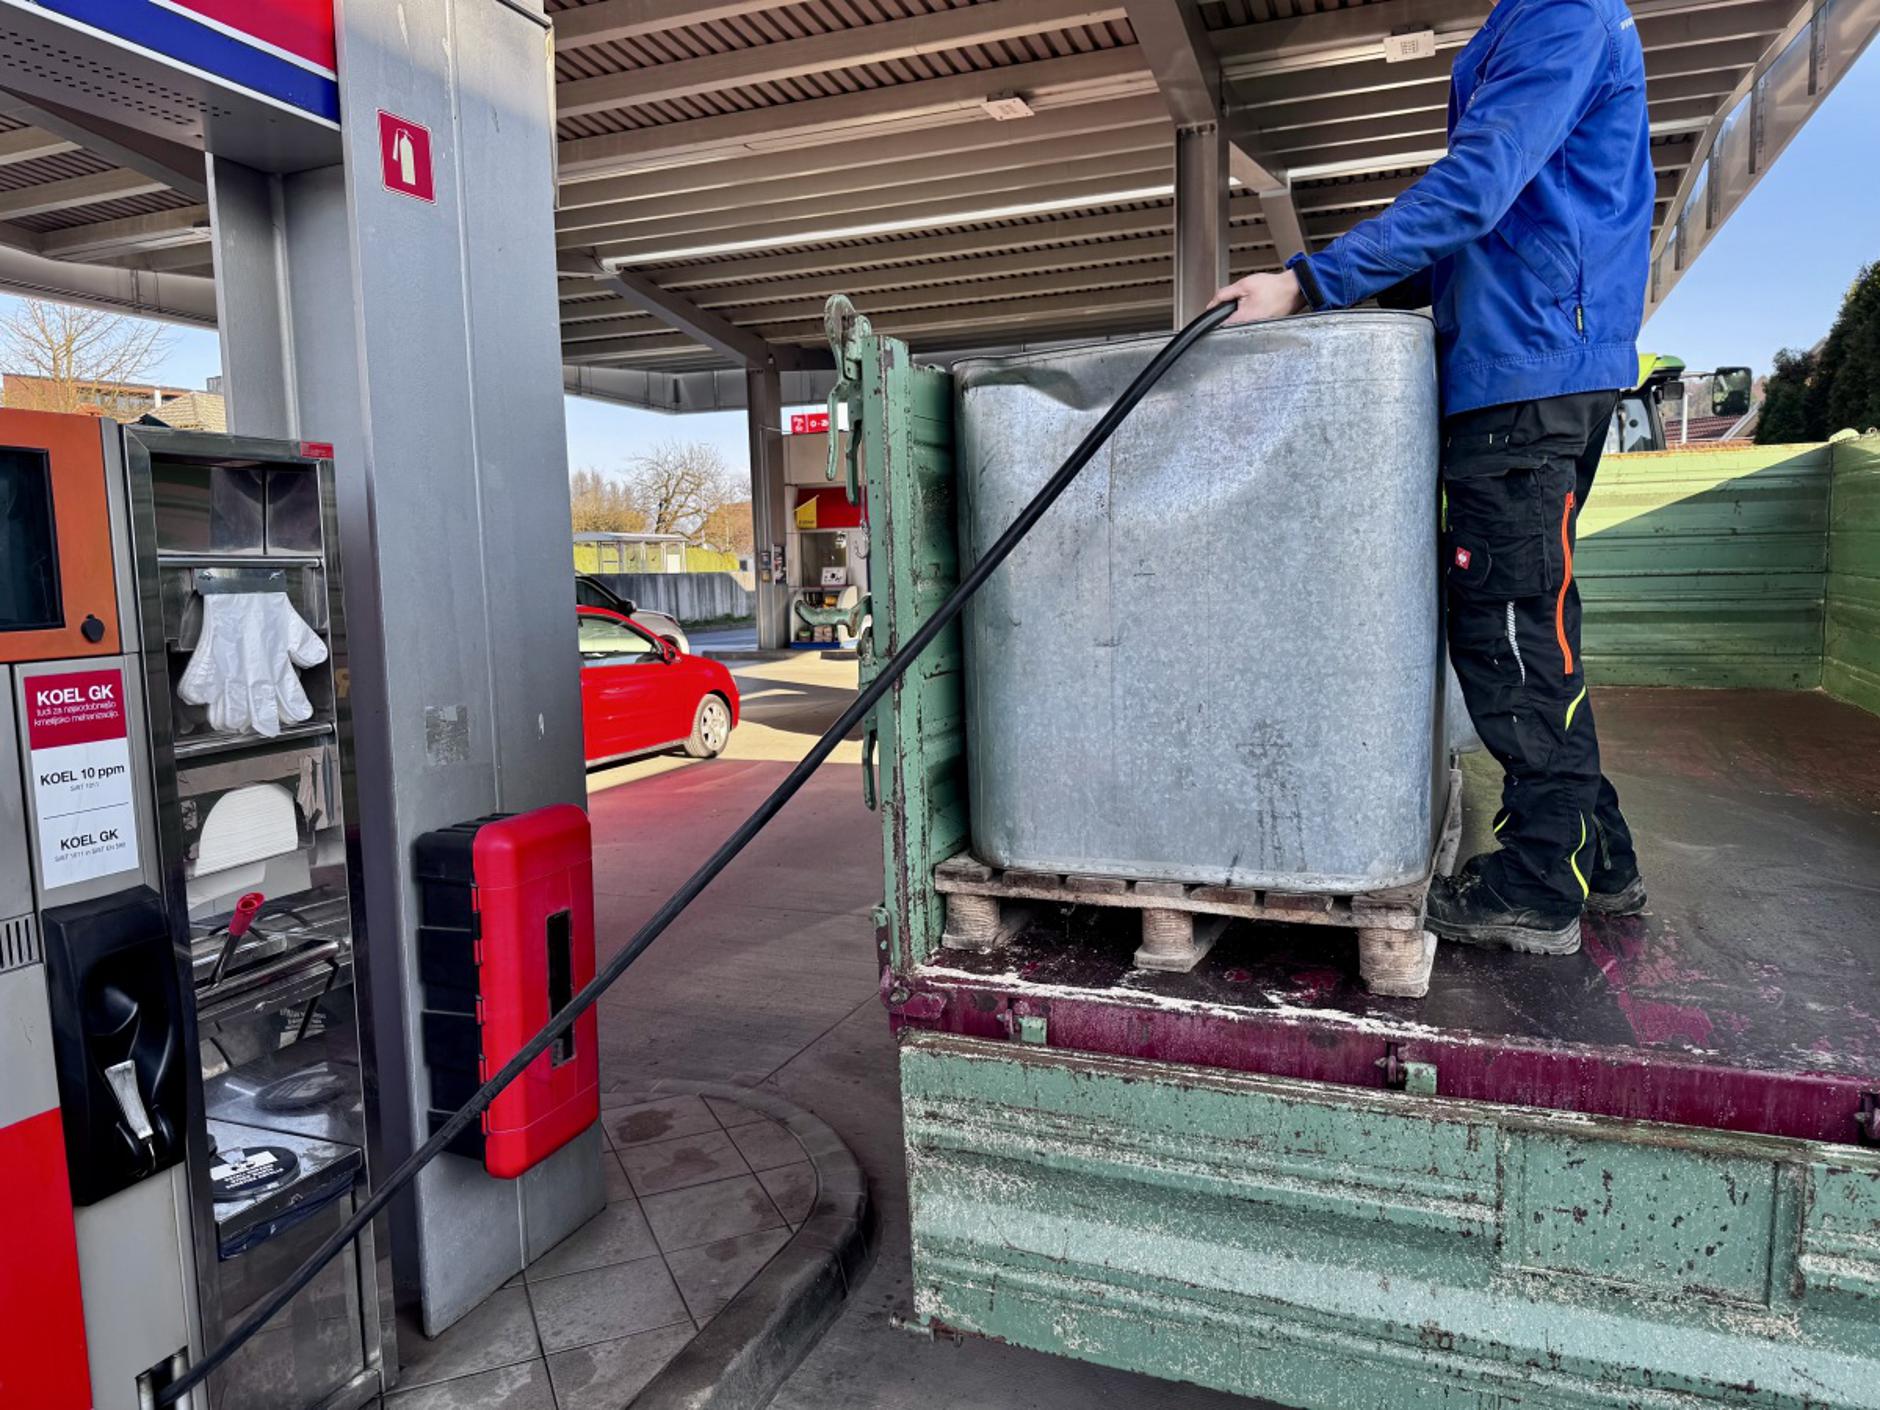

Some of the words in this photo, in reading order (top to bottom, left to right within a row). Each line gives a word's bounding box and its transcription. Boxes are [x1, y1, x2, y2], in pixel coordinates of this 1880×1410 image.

[37, 687, 85, 706] KOEL
[88, 684, 114, 701] GK
[40, 770, 78, 786] KOEL
[81, 767, 95, 780] 10
[98, 764, 125, 780] ppm
[60, 833, 97, 851] KOEL
[99, 828, 119, 842] GK
